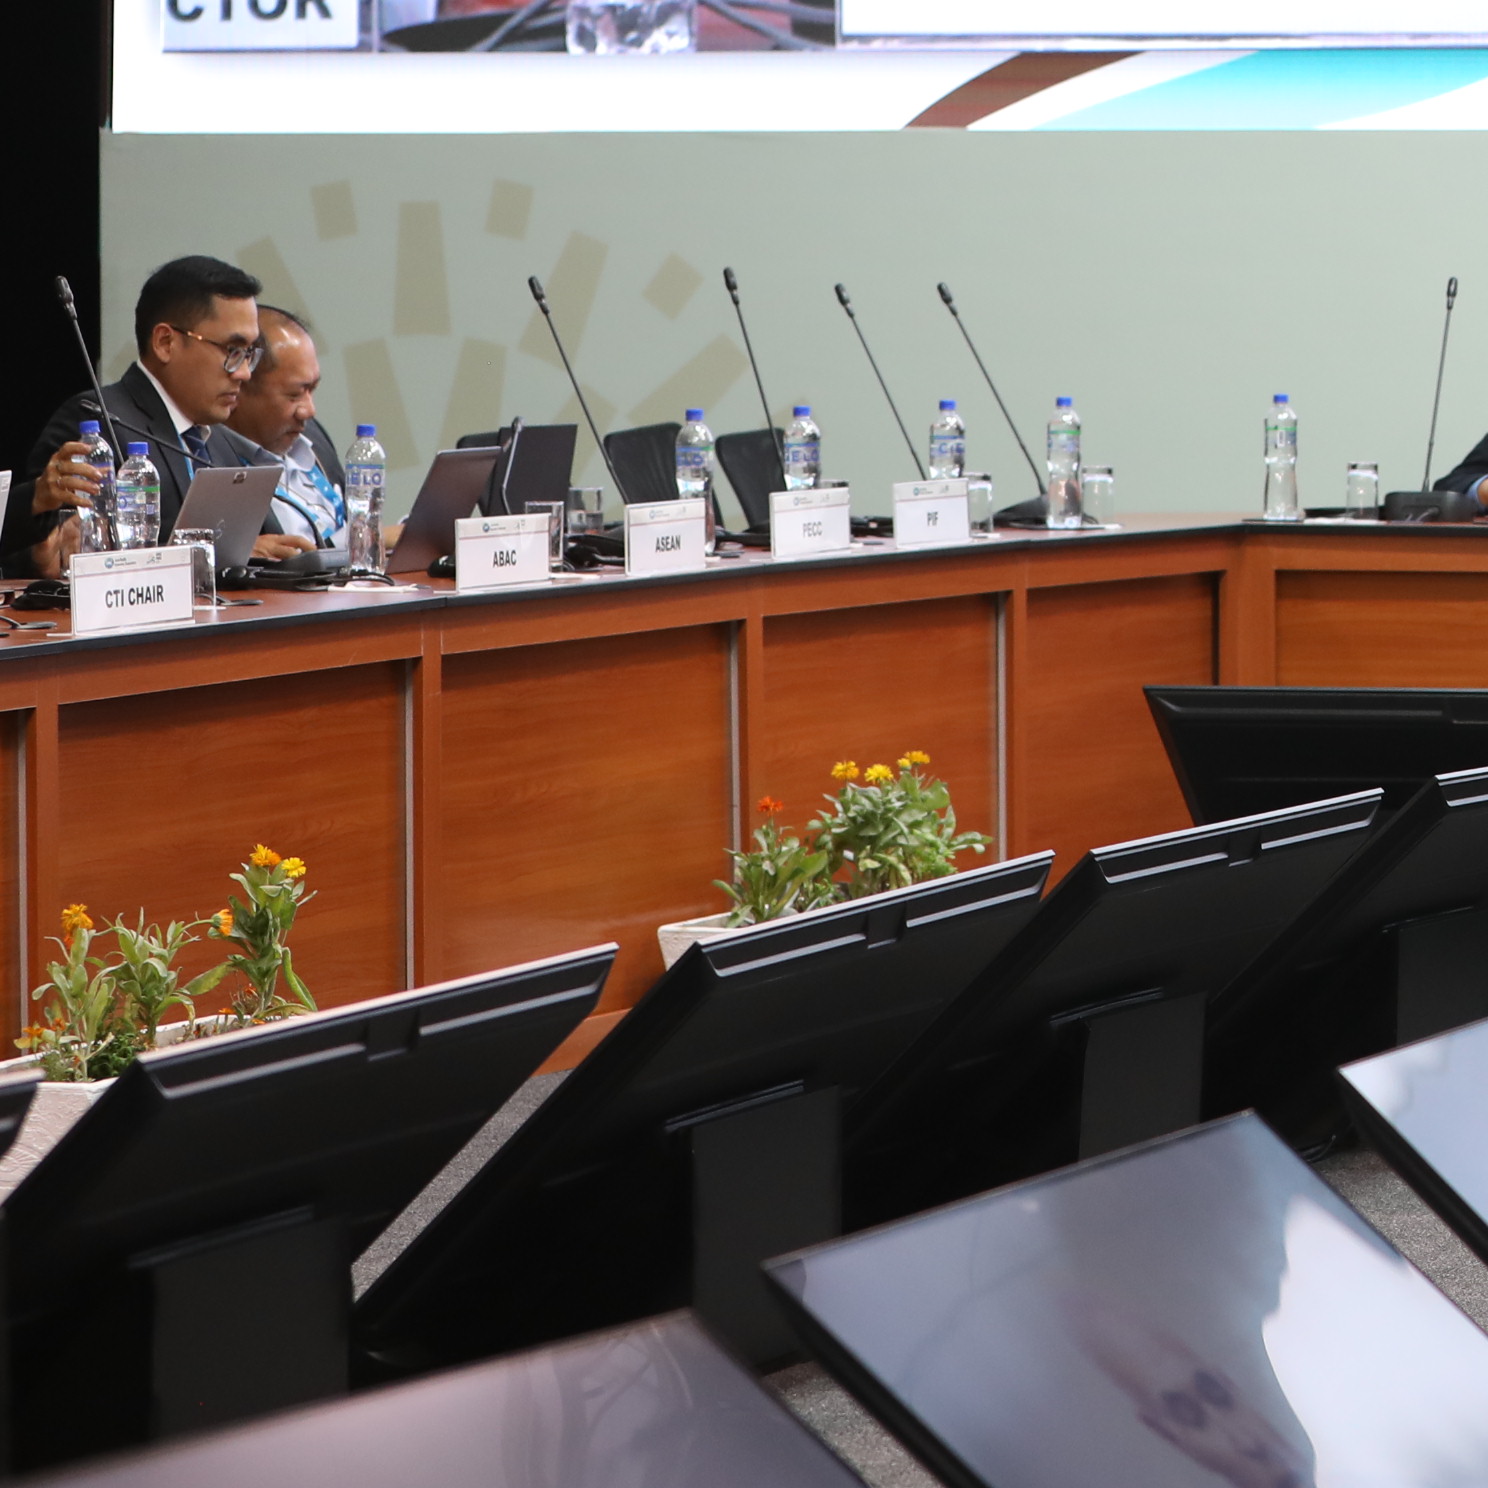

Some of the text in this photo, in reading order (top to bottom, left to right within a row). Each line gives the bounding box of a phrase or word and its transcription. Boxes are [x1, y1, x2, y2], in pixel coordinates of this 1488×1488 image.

[926, 511, 939, 526] PIF
[801, 521, 823, 538] PECC
[655, 535, 681, 552] ASEAN
[492, 549, 517, 567] ABAC
[105, 584, 164, 609] CTI CHAIR
